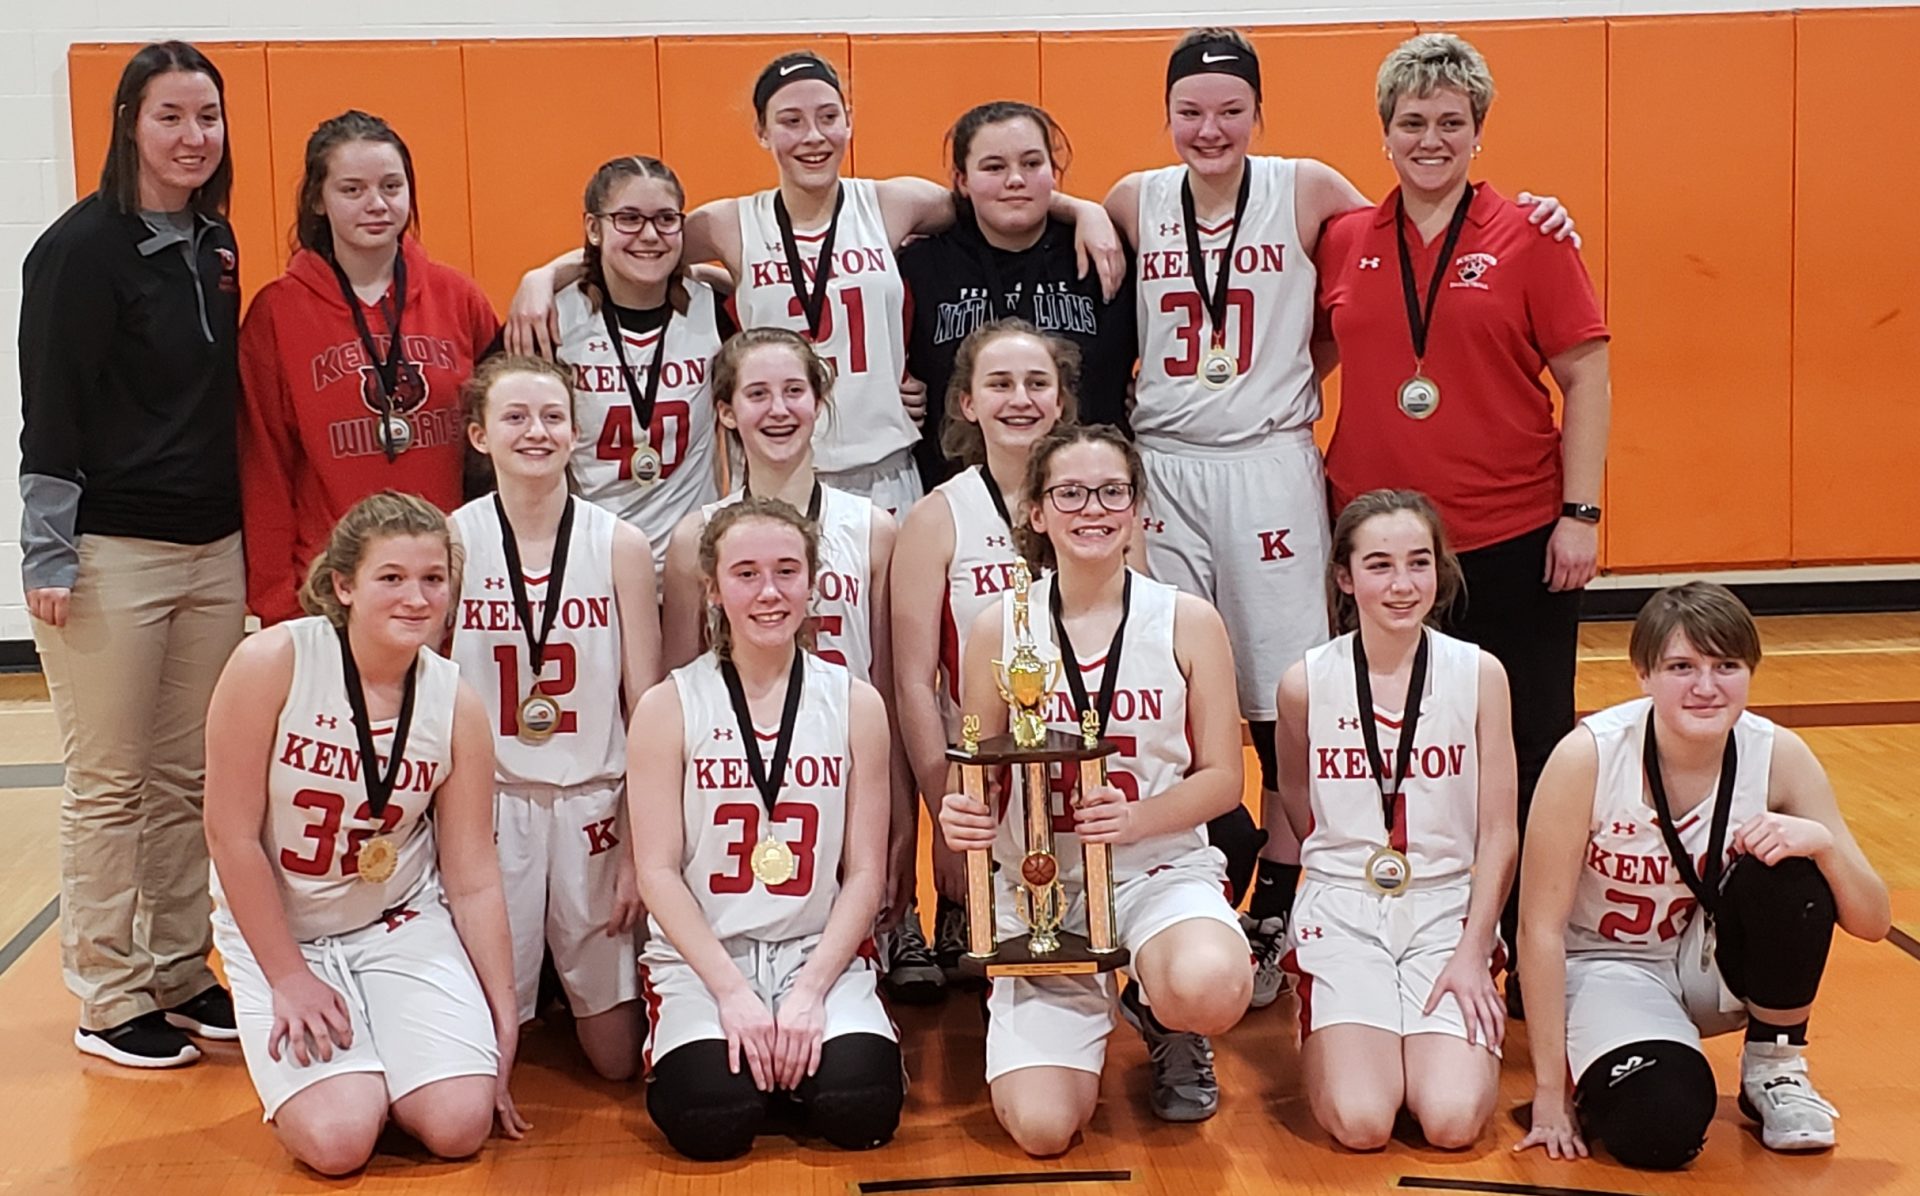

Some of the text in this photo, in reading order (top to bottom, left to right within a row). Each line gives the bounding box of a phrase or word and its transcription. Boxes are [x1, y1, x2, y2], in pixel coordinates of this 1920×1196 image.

[934, 293, 1097, 344] NITT LIONS
[1160, 288, 1255, 378] 30
[329, 408, 461, 459] WILATS
[596, 400, 690, 481] 40
[1257, 528, 1295, 562] K
[493, 642, 578, 737] 12
[1037, 689, 1163, 723] ENON
[582, 816, 620, 857] K
[709, 802, 819, 897] 33
[1588, 841, 1738, 885] KEN
